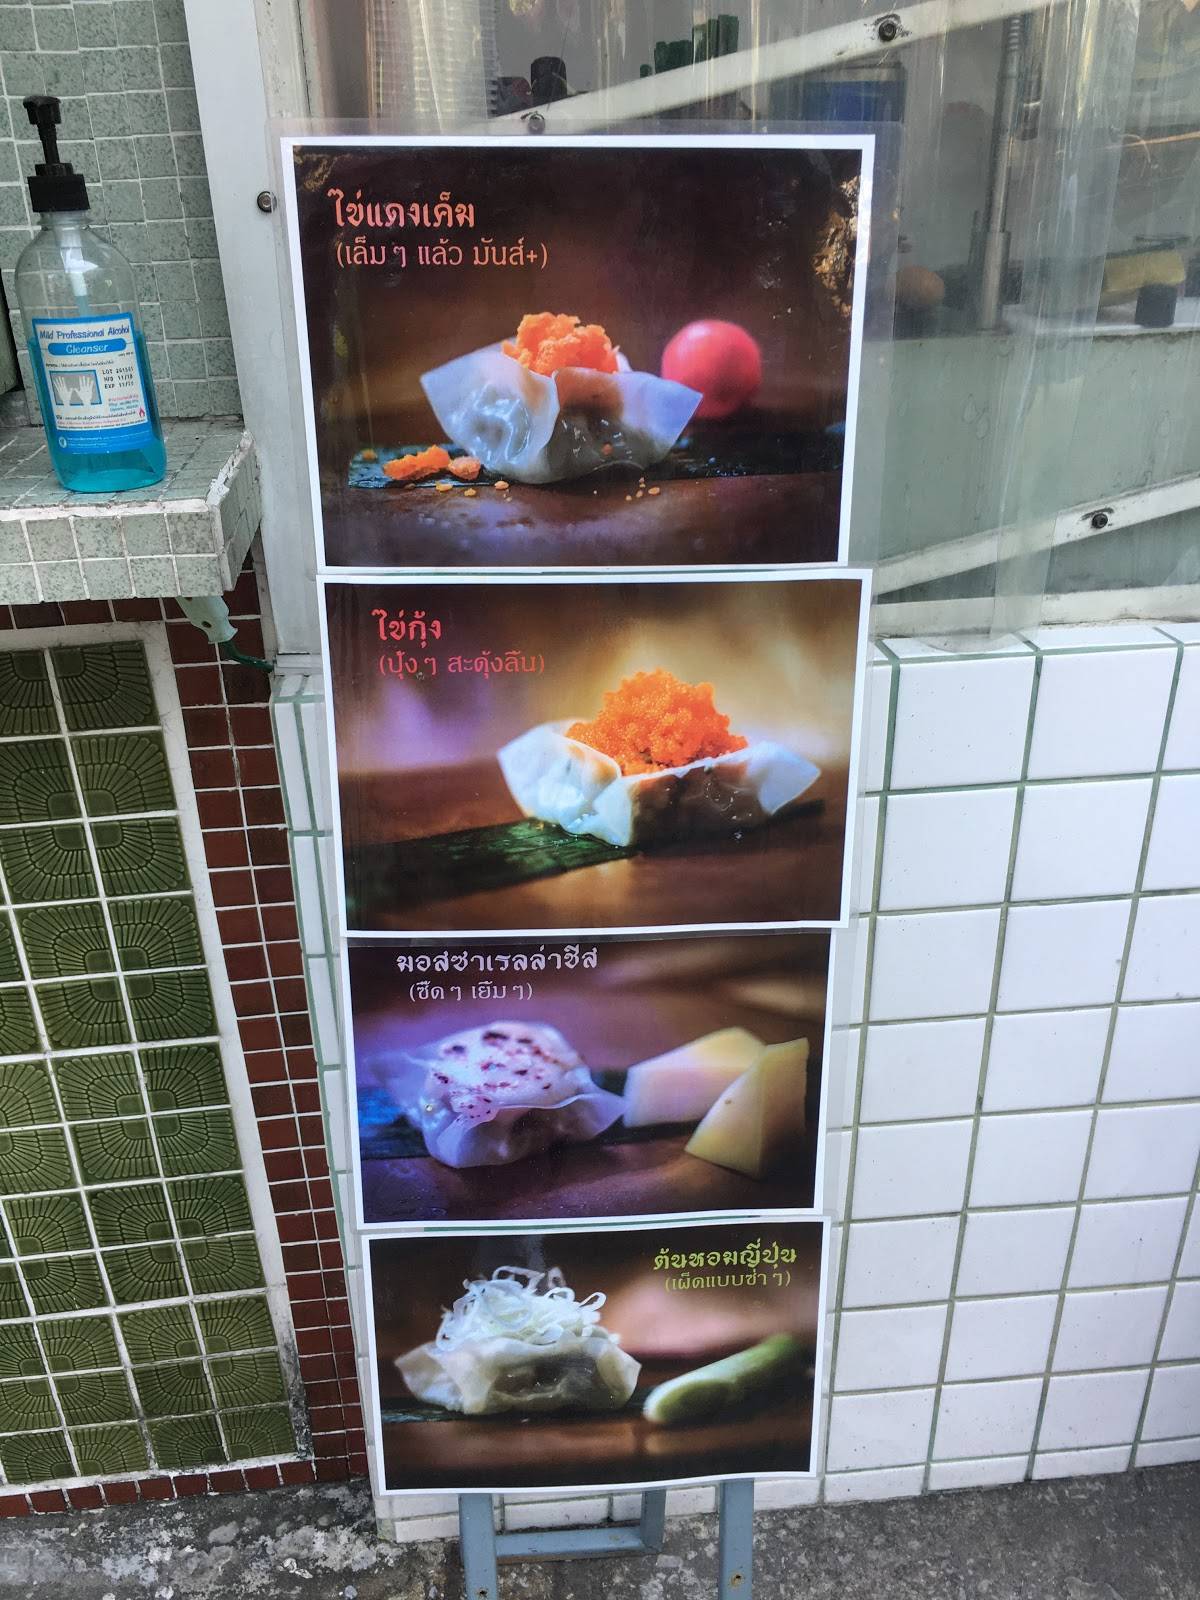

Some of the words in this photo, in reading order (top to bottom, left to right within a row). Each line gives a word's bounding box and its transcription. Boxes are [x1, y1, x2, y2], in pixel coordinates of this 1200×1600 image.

[327, 188, 476, 228] ไข่แดงเค็ม
[418, 238, 463, 266] แล้ว
[40, 329, 54, 340] Mild
[56, 328, 105, 340] Professional
[108, 325, 130, 336] Alcohol
[65, 343, 109, 354] Cleanser
[371, 608, 442, 649] ไข่กุ้ง
[396, 943, 598, 973] มอสซาเรลล่าชีส
[652, 1237, 798, 1270] ต้นหอมญี่ปุ่น
